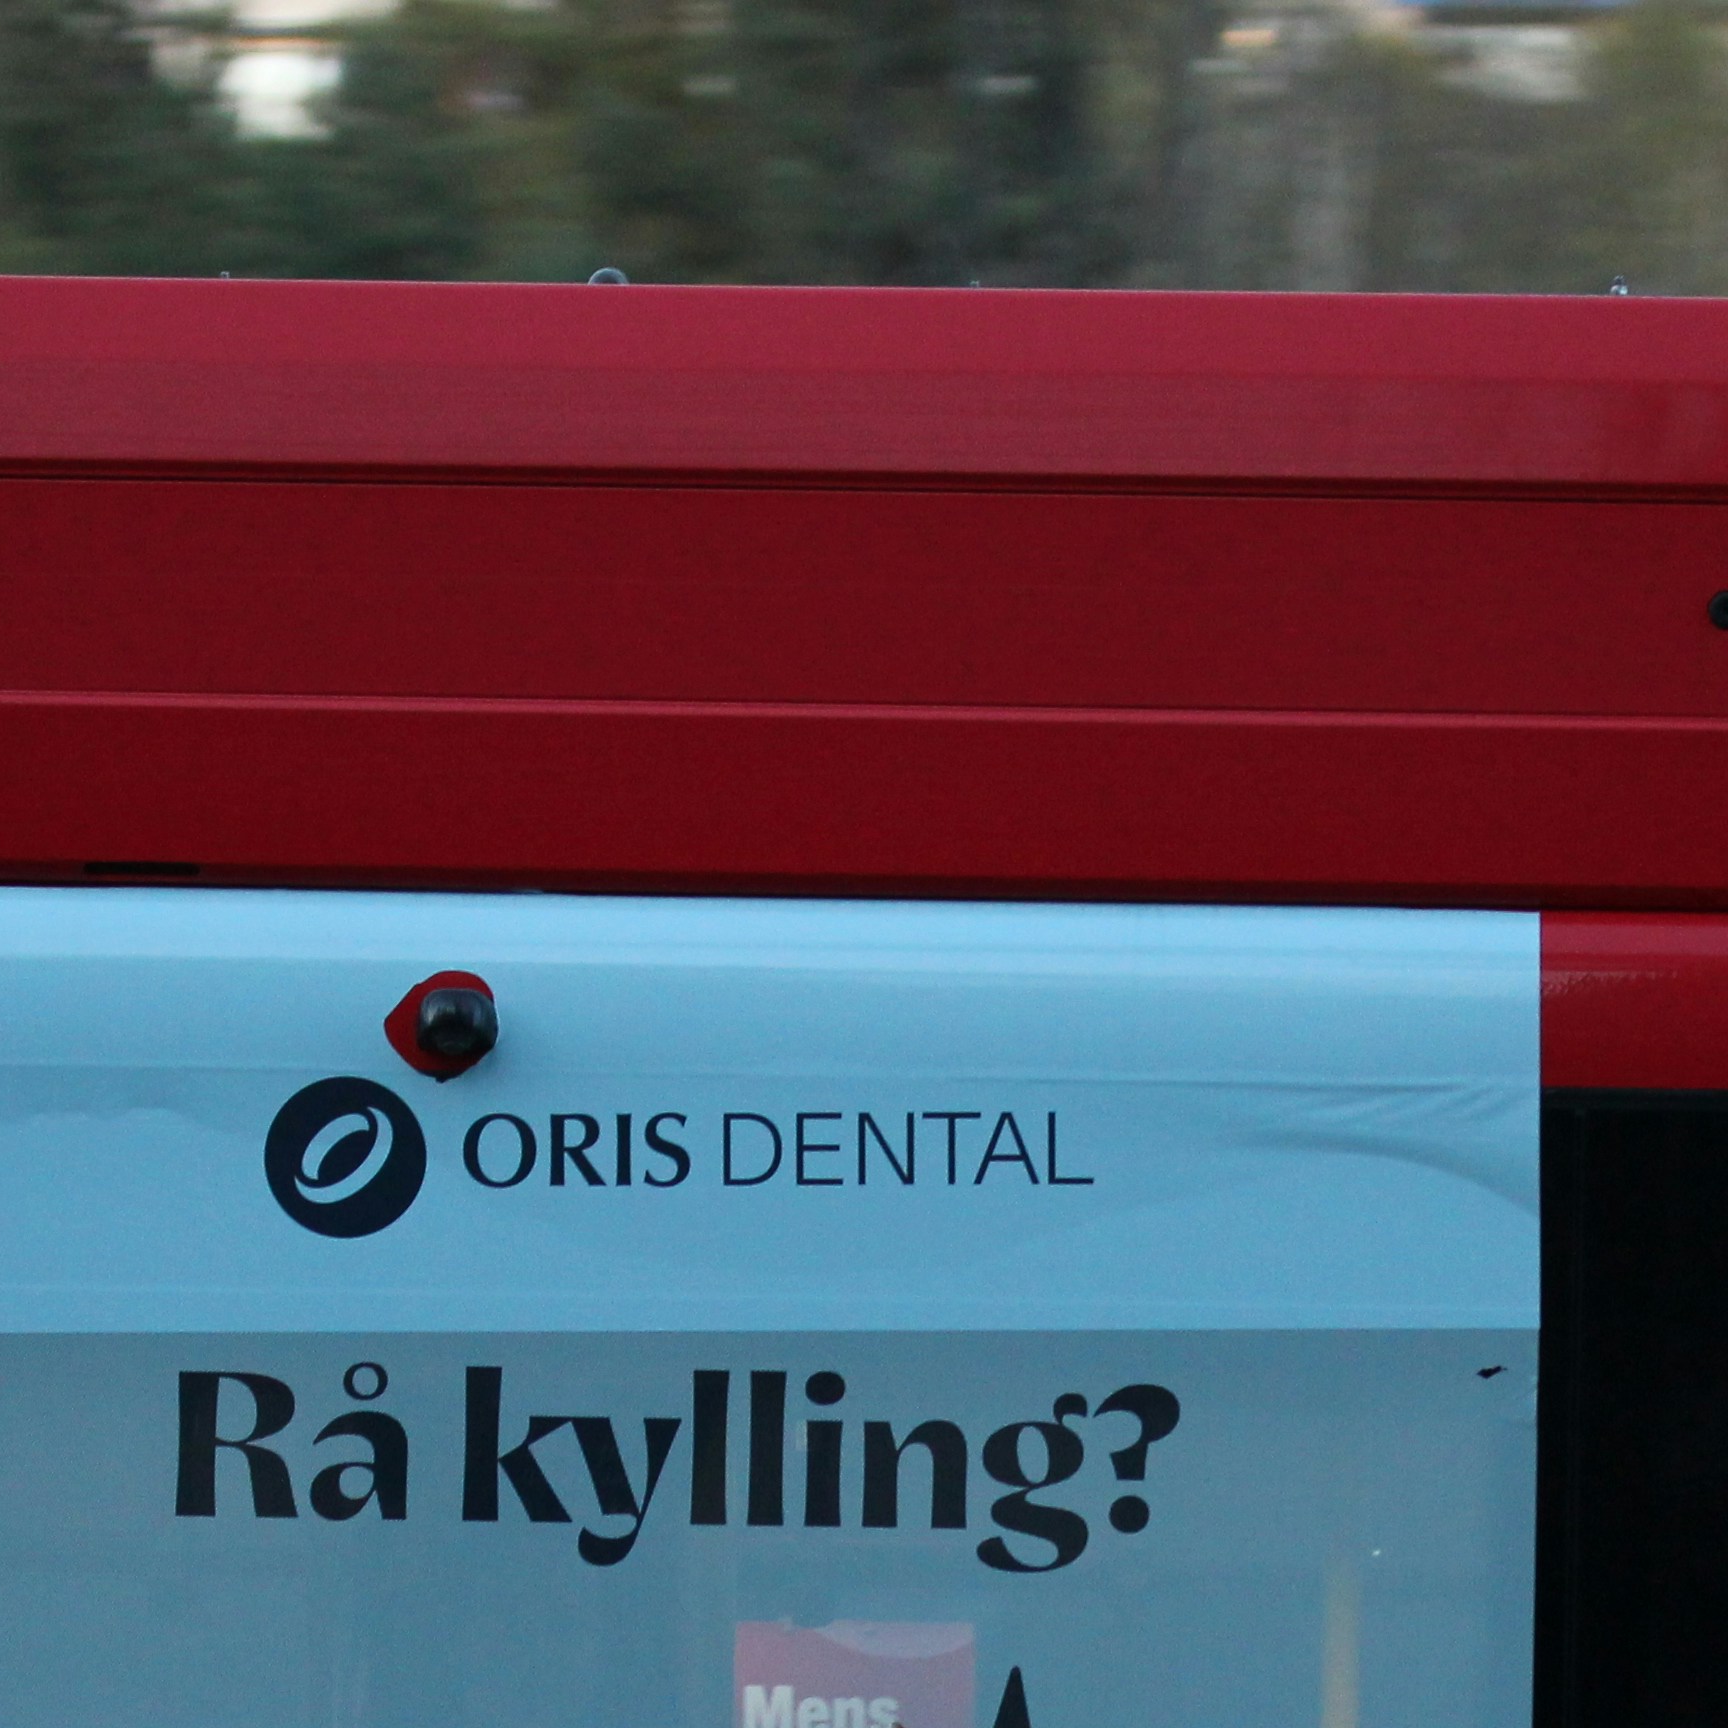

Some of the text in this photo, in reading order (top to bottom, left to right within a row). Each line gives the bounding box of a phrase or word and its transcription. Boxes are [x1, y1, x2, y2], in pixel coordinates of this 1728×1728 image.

[462, 1110, 1095, 1188] ORIS DENTAL
[174, 1360, 1181, 1573] Rå kylling?
